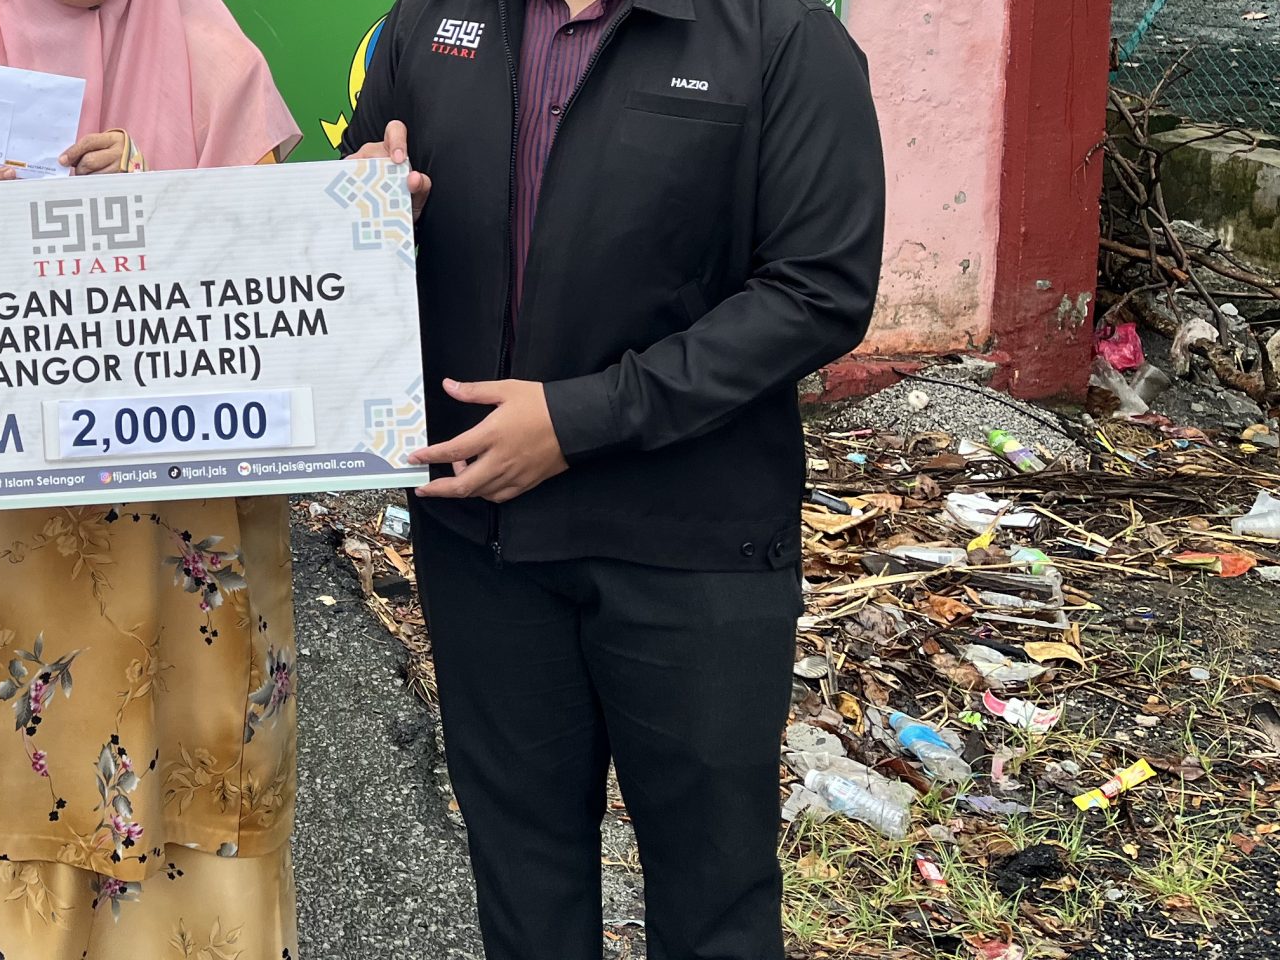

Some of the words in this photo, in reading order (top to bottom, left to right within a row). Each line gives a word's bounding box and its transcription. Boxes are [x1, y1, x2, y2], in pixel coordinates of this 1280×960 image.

[431, 43, 476, 59] TIJARI
[671, 77, 709, 90] HAZIQ
[34, 254, 148, 276] TIJARI
[86, 281, 191, 315] DANA
[200, 272, 345, 308] TABUNG
[116, 314, 212, 347] UMAT
[223, 308, 328, 341] ISLAM
[134, 344, 262, 387] (TIJARI)
[71, 401, 267, 453] 2,000.00
[182, 465, 227, 479] tijari.jais
[252, 458, 365, 474] tijari.jais@gmail.com
[4, 476, 35, 488] Islam
[37, 474, 85, 487] Selangor
[112, 470, 157, 483] tijari.jais
